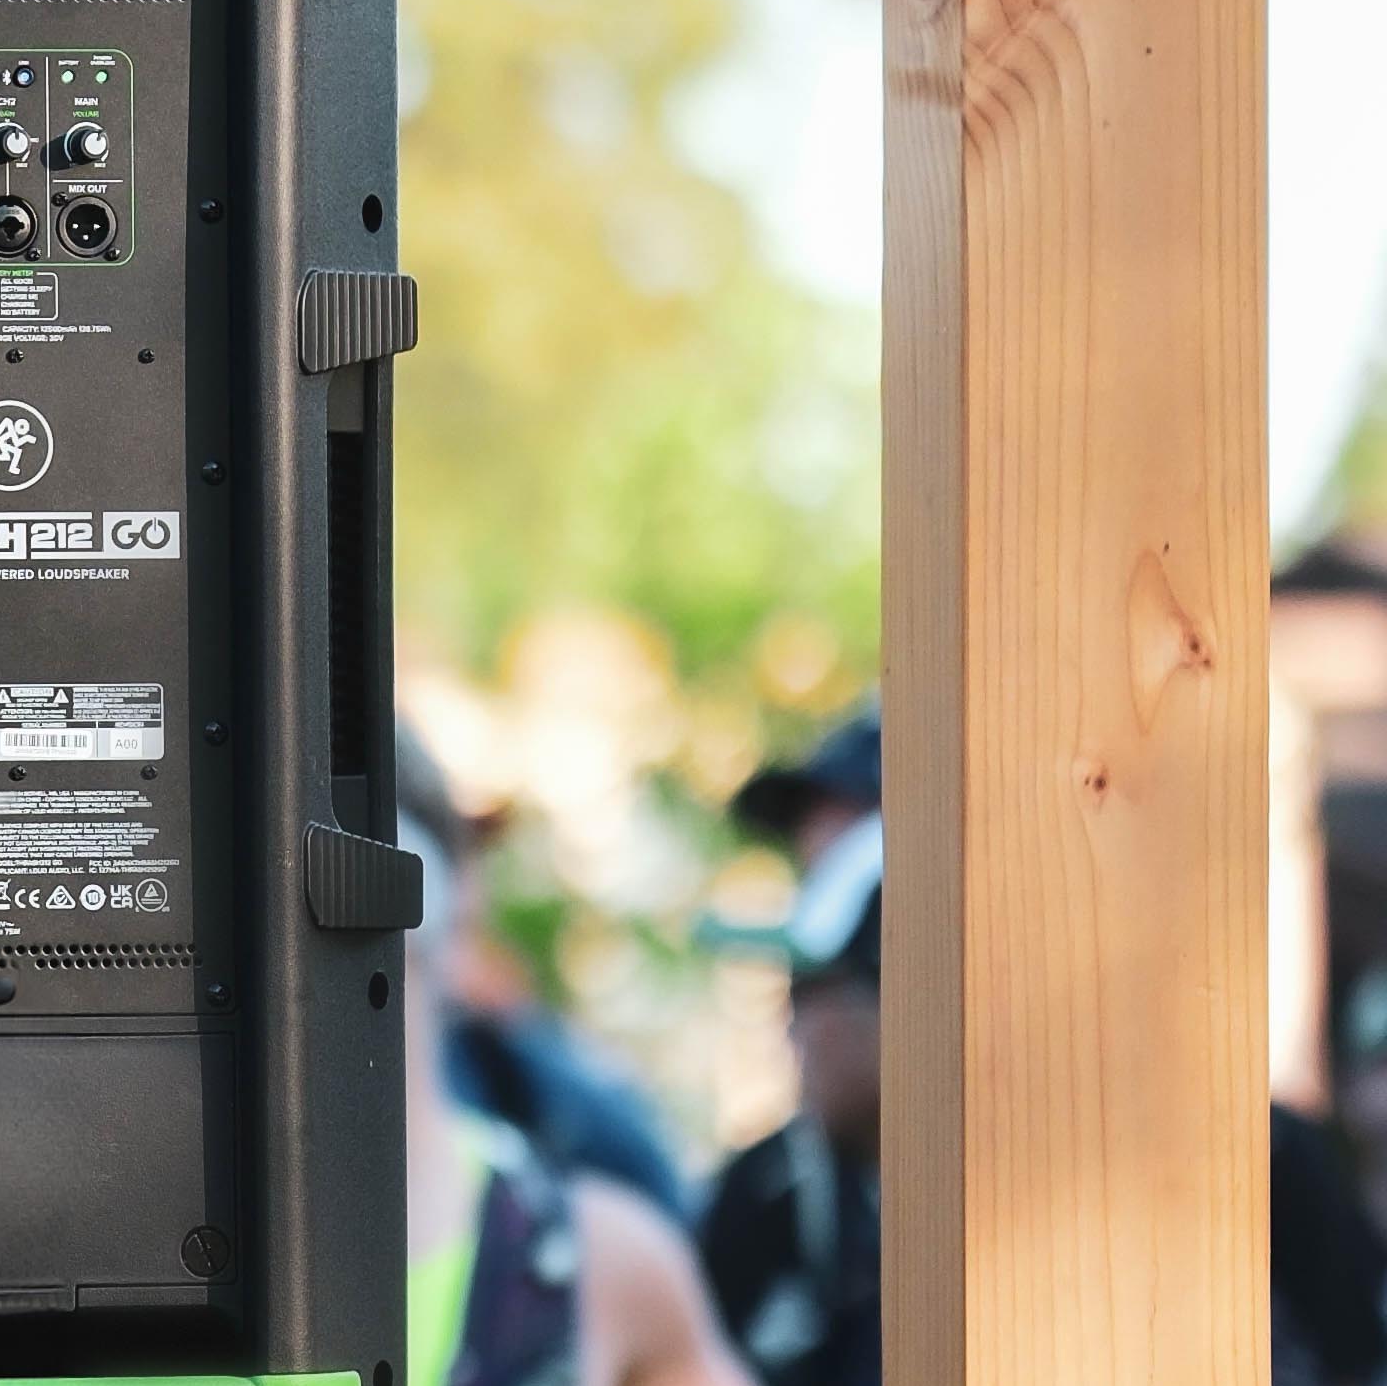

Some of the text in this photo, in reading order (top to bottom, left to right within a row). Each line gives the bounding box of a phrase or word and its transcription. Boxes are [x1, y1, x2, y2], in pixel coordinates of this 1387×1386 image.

[74, 97, 99, 106] MAIN
[68, 185, 107, 193] MIX OUT
[111, 517, 172, 551] GO
[37, 569, 130, 580] LOUDSPEAKER
[114, 739, 139, 750] A00
[109, 884, 133, 897] UK
